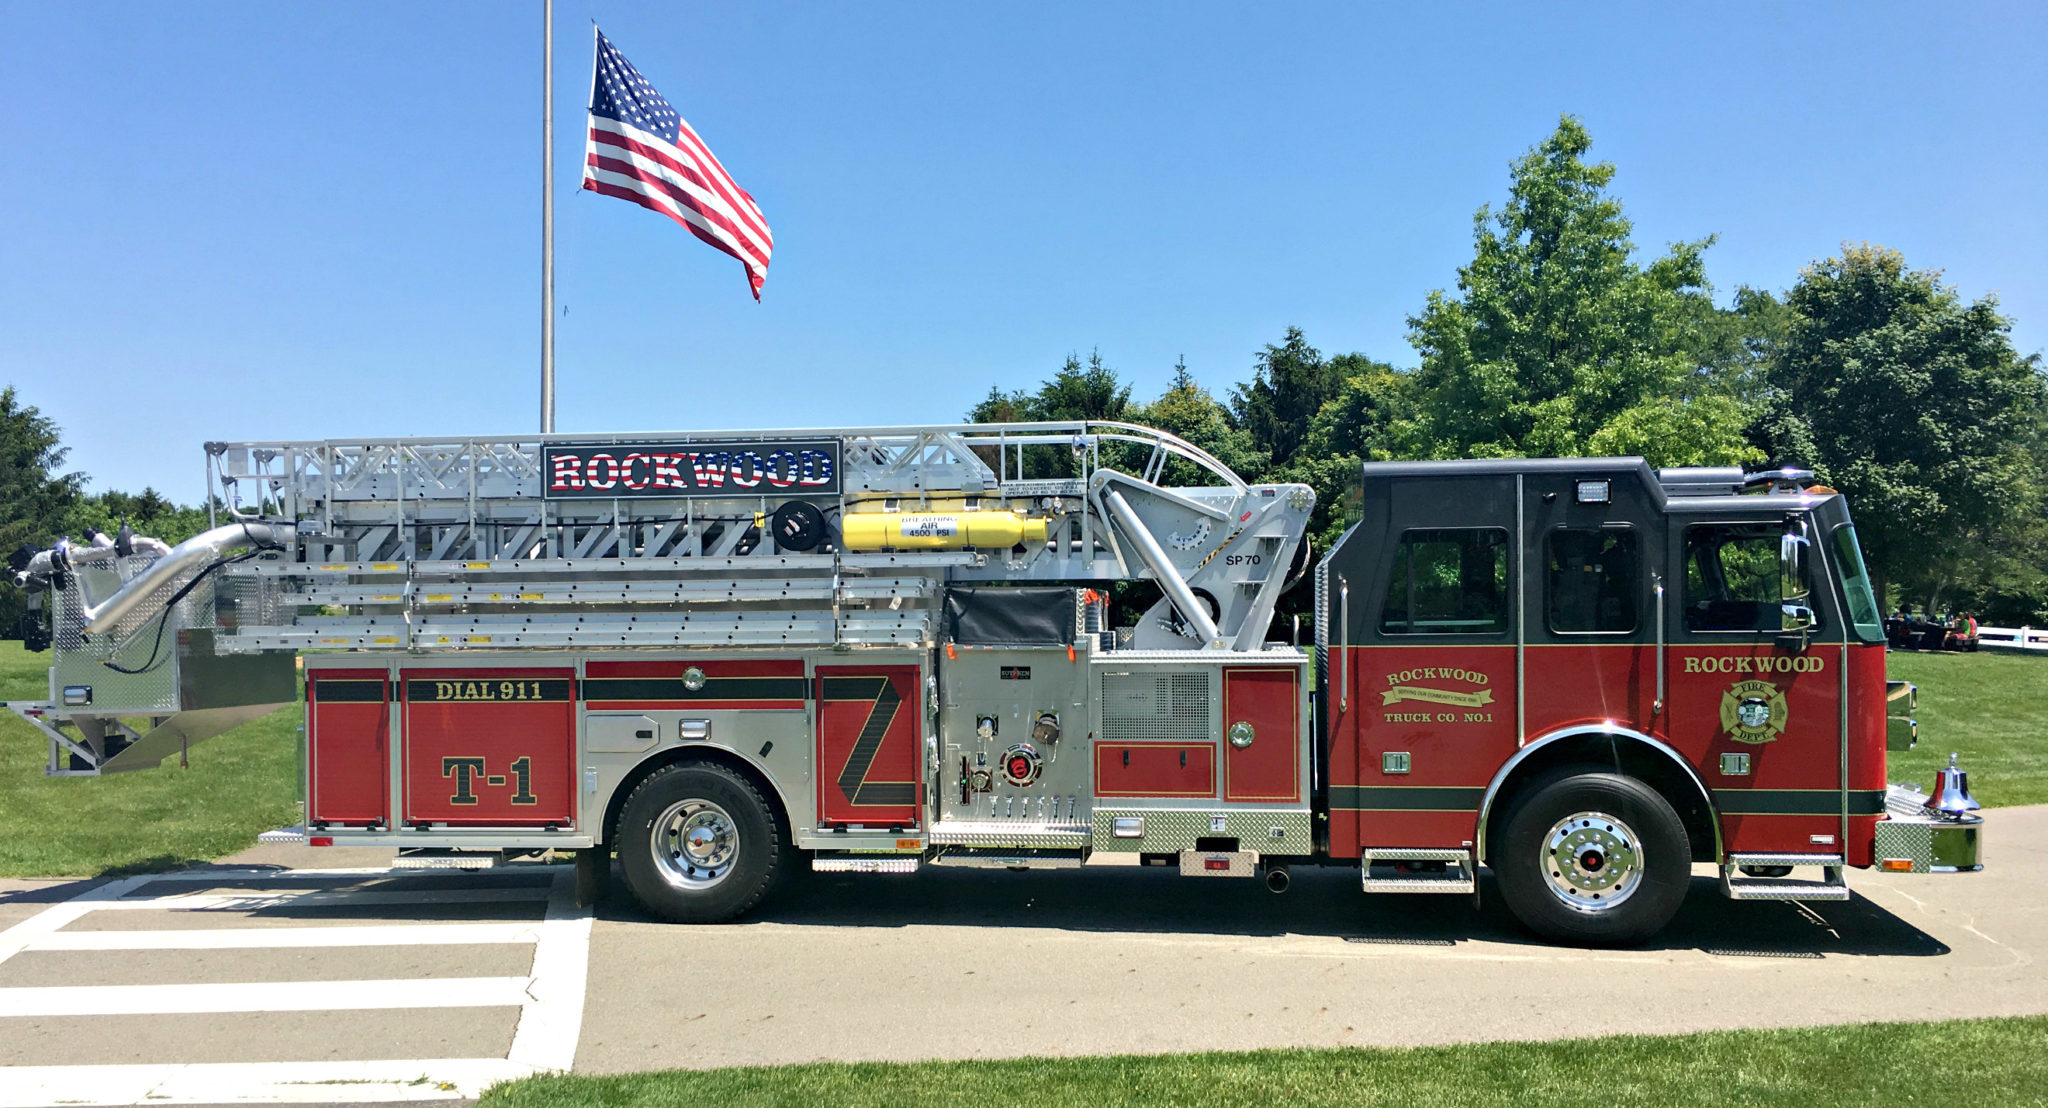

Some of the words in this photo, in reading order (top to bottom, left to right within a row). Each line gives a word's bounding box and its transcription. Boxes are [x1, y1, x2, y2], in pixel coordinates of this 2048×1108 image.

[551, 450, 833, 491] ROCKWOOD
[909, 529, 931, 537] 4500
[936, 529, 950, 537] PSI
[920, 522, 938, 530] AIR
[1226, 555, 1243, 565] SP
[1245, 554, 1261, 565] 70
[1683, 656, 1825, 673] ROCKWOOD
[1386, 667, 1489, 686] ROCKWOOD
[436, 682, 495, 700] DIAL
[500, 682, 543, 700] 911
[1741, 682, 1766, 692] FIRE
[1384, 713, 1432, 723] TRUCK
[1437, 713, 1458, 723] CO.
[1463, 713, 1493, 723] NO.1
[442, 756, 538, 806] T-1
